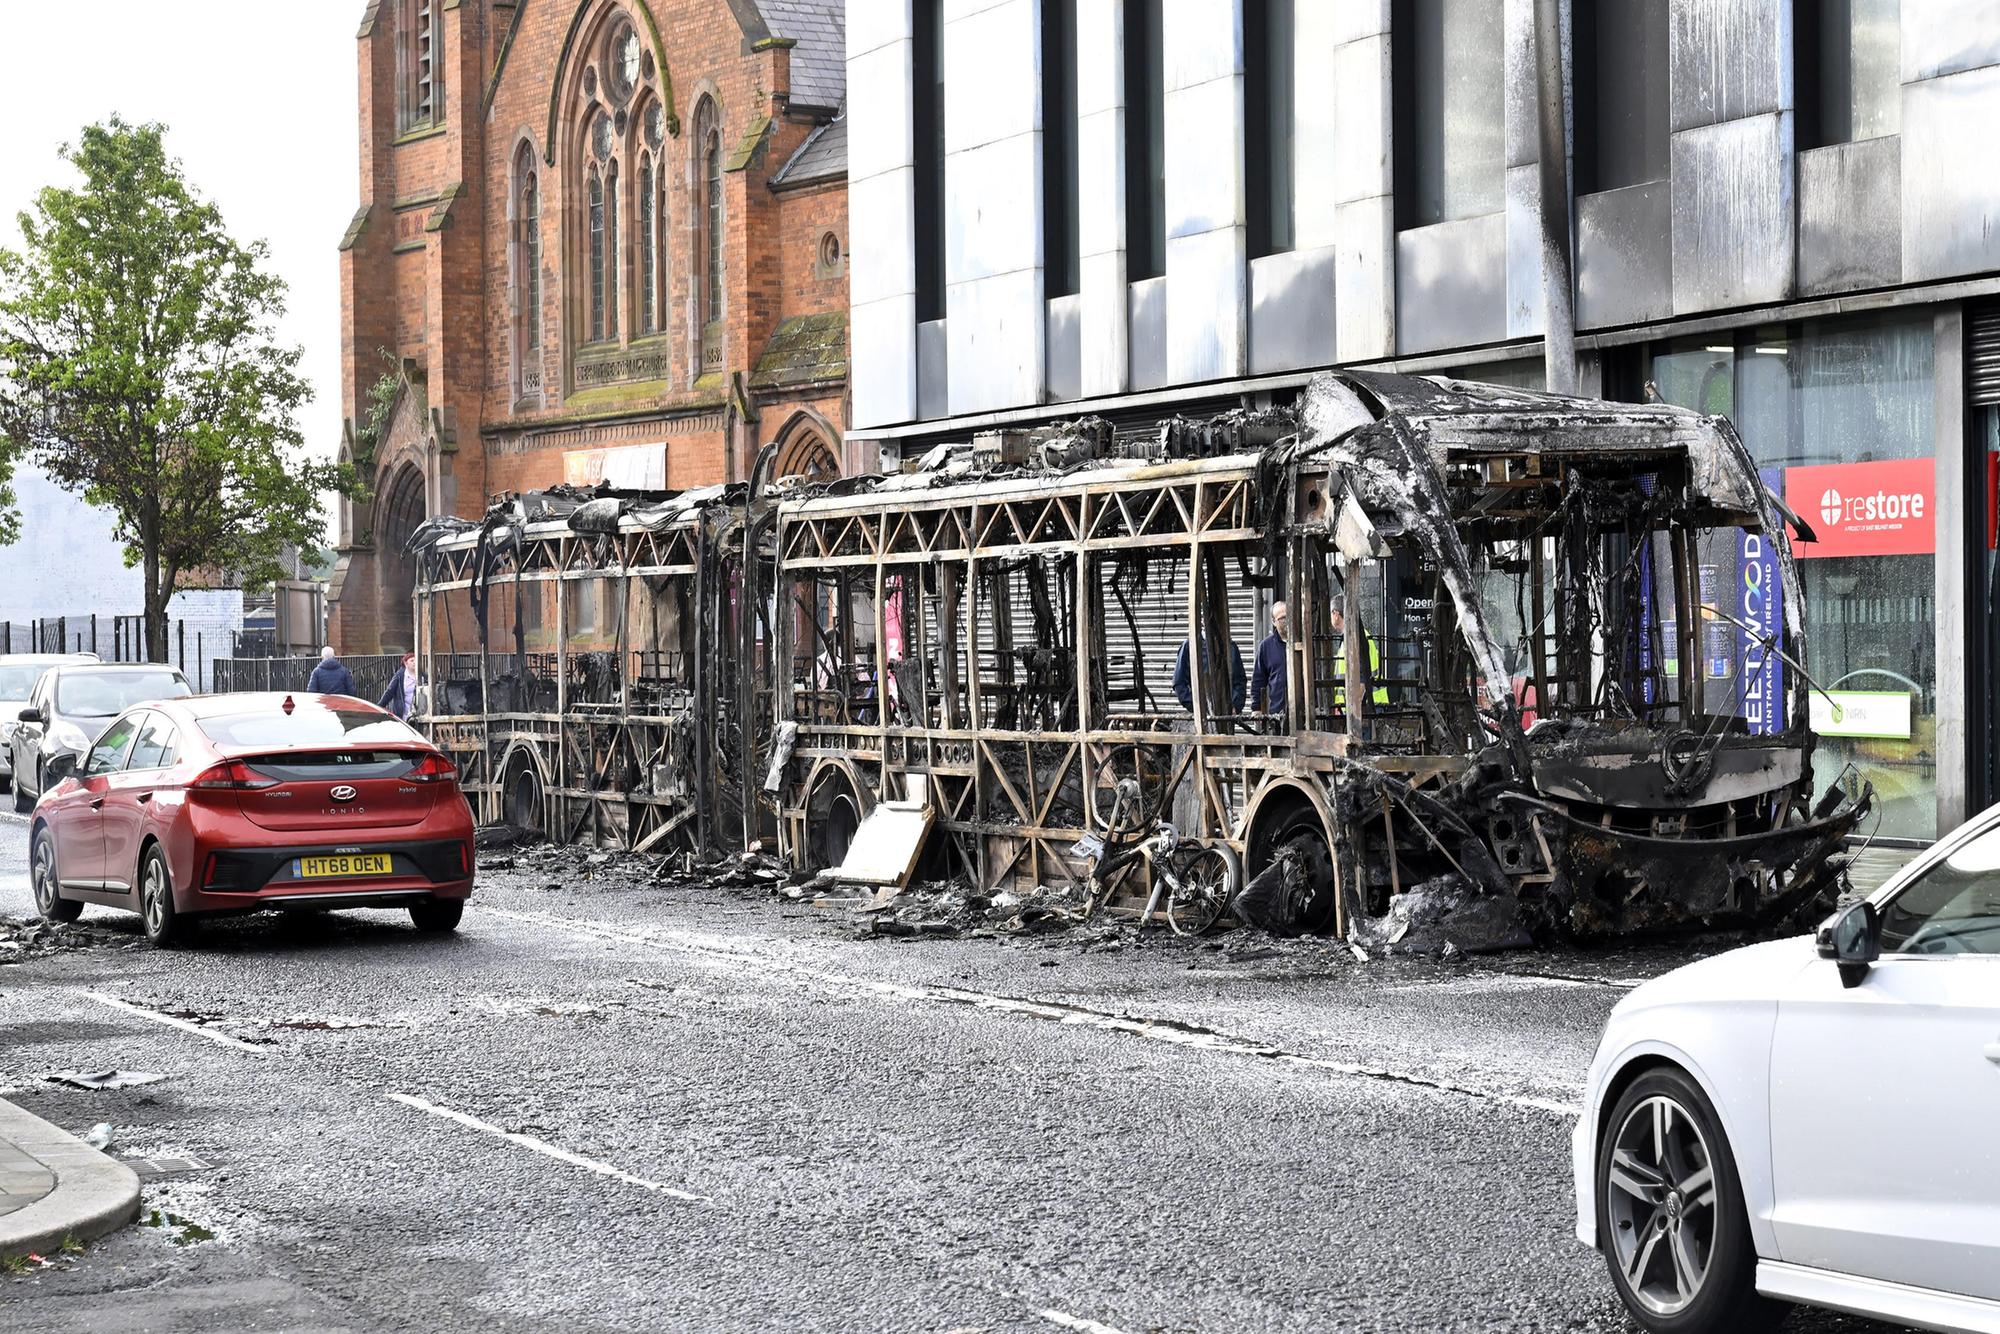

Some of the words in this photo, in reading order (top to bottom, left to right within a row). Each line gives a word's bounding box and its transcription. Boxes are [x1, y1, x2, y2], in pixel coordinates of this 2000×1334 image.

[1844, 490, 1924, 522] restore
[1765, 563, 1773, 623] IRELAND
[1404, 614, 1421, 622] Mon
[307, 859, 349, 874] HT68
[354, 857, 384, 872] OEN
